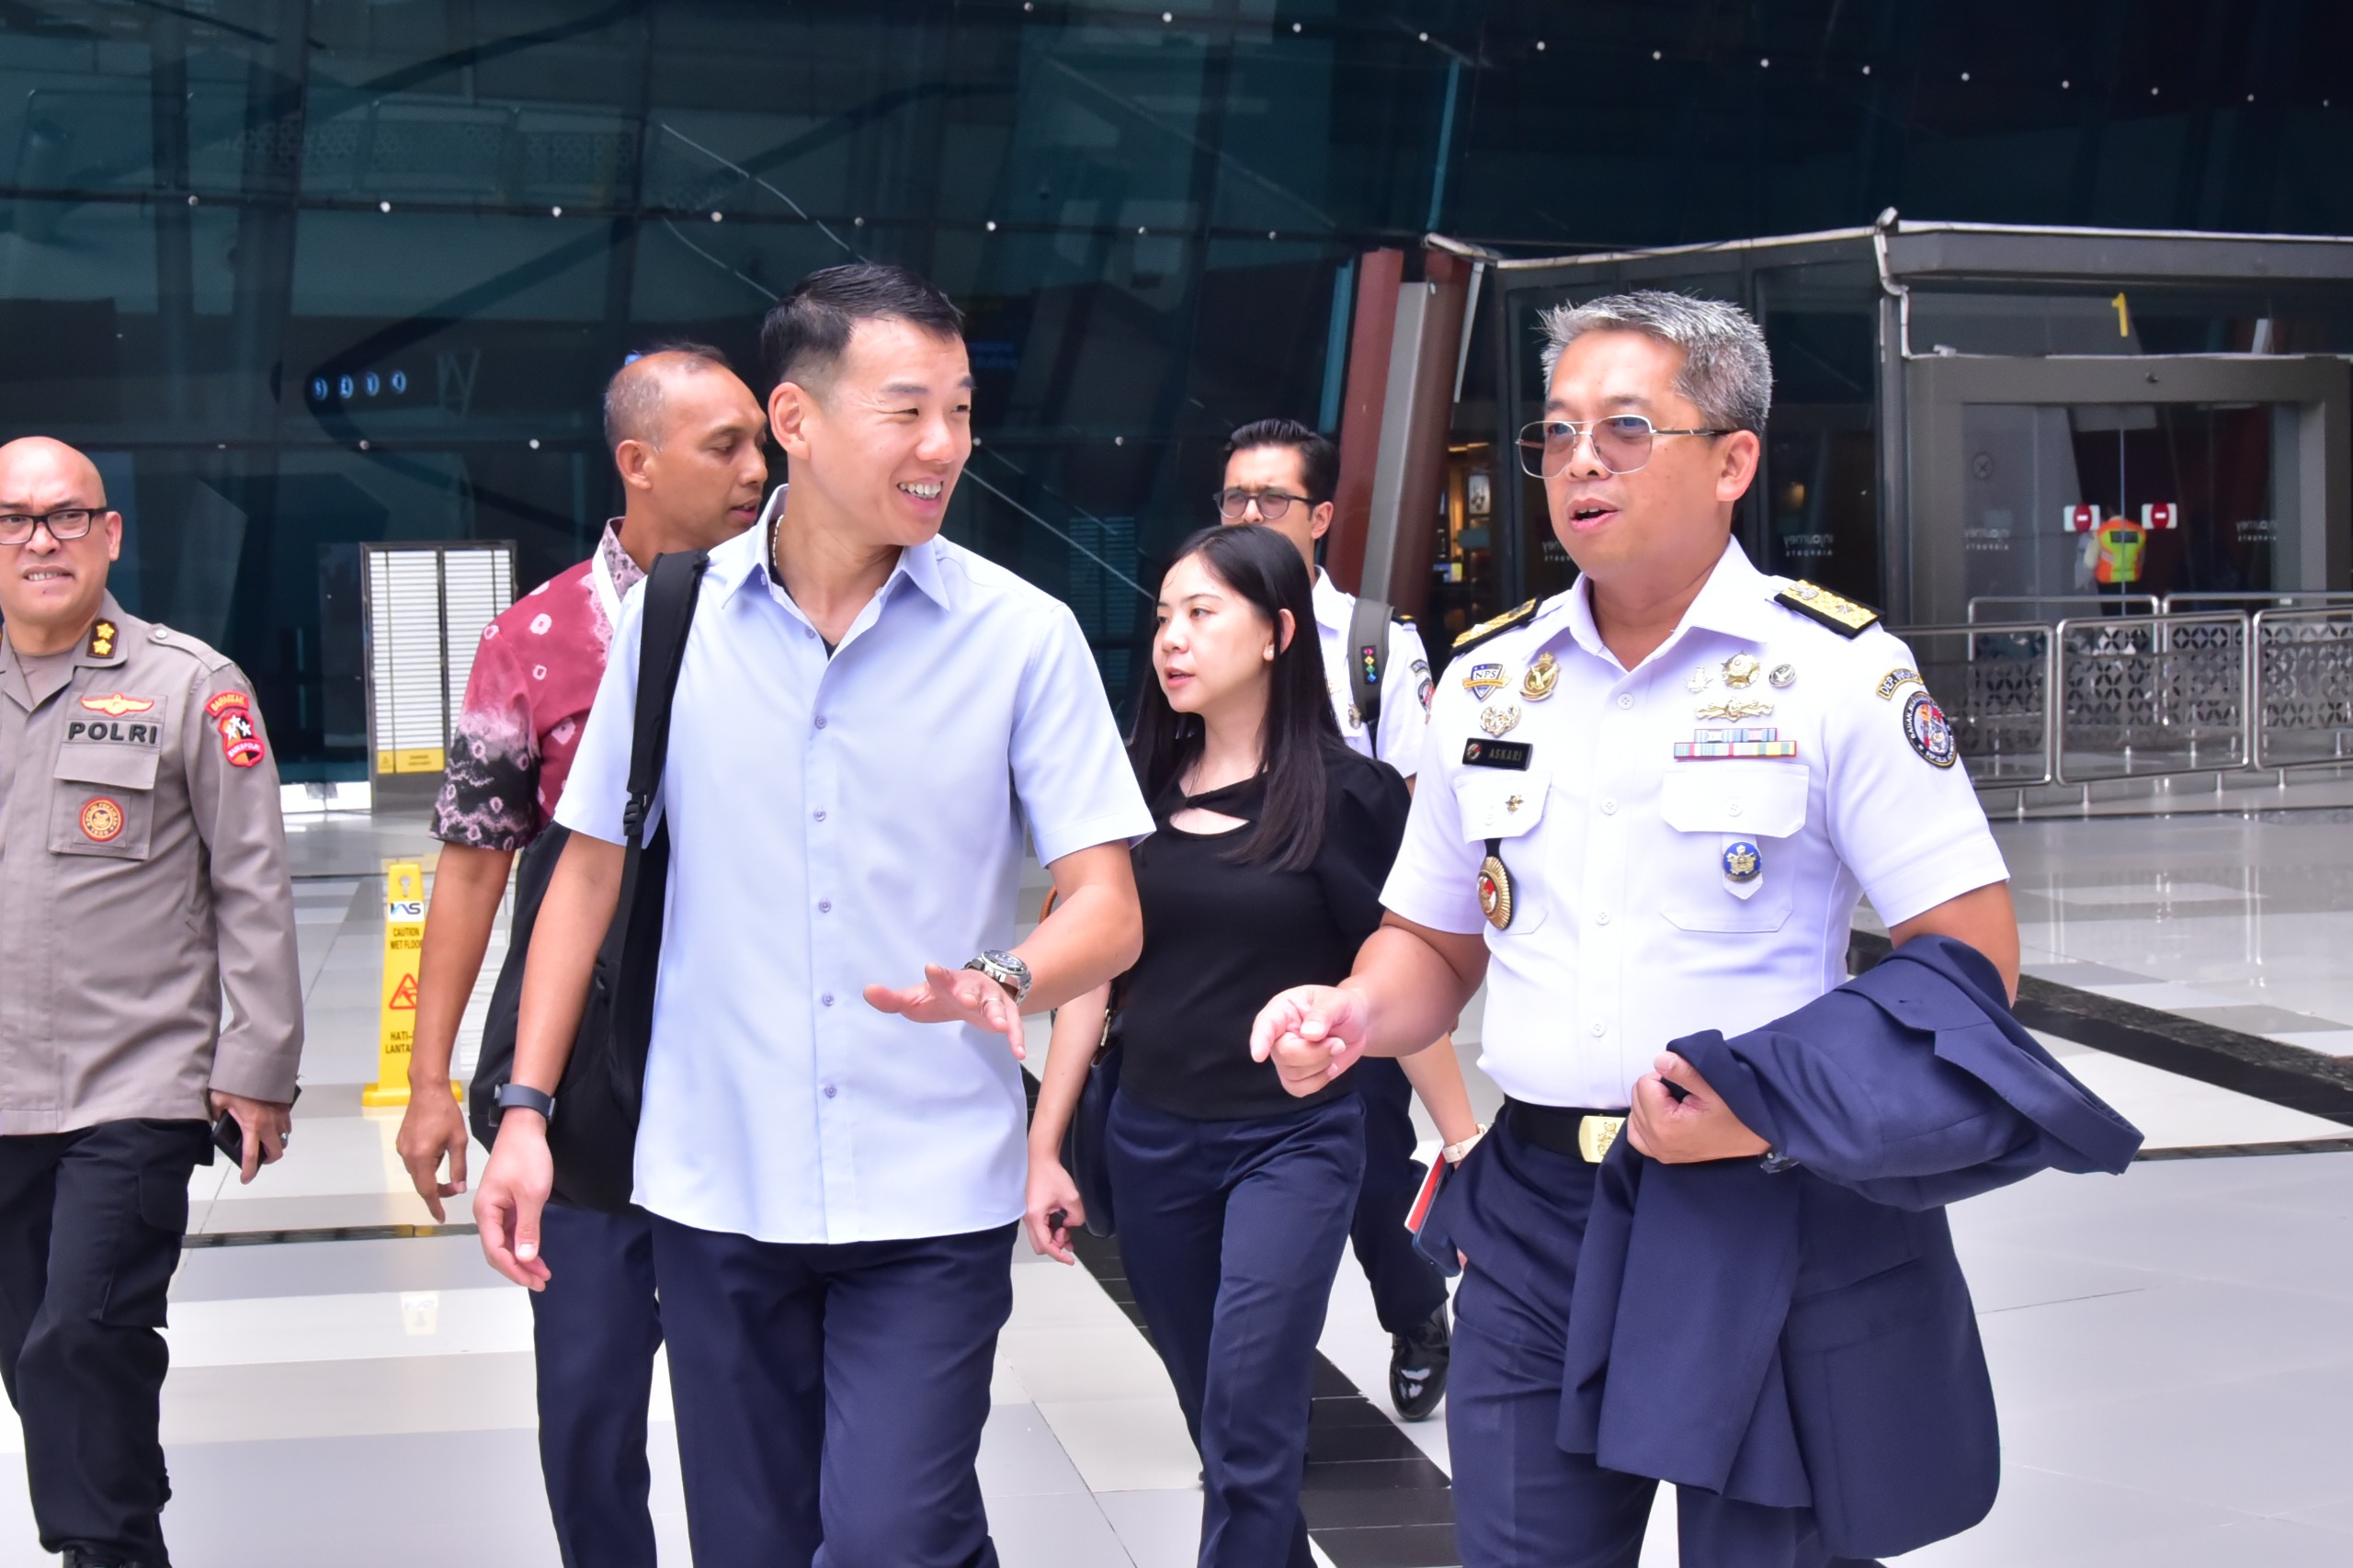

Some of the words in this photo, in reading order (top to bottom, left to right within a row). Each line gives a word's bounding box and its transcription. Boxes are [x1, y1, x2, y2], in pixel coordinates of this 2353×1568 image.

[2111, 292, 2128, 337] 1
[1475, 670, 1497, 679] NPS
[68, 722, 157, 744] POLRI
[1488, 748, 1522, 762] ASKARI
[393, 927, 420, 937] CAUTION
[391, 940, 403, 949] WET
[385, 1043, 412, 1054] LANTA
